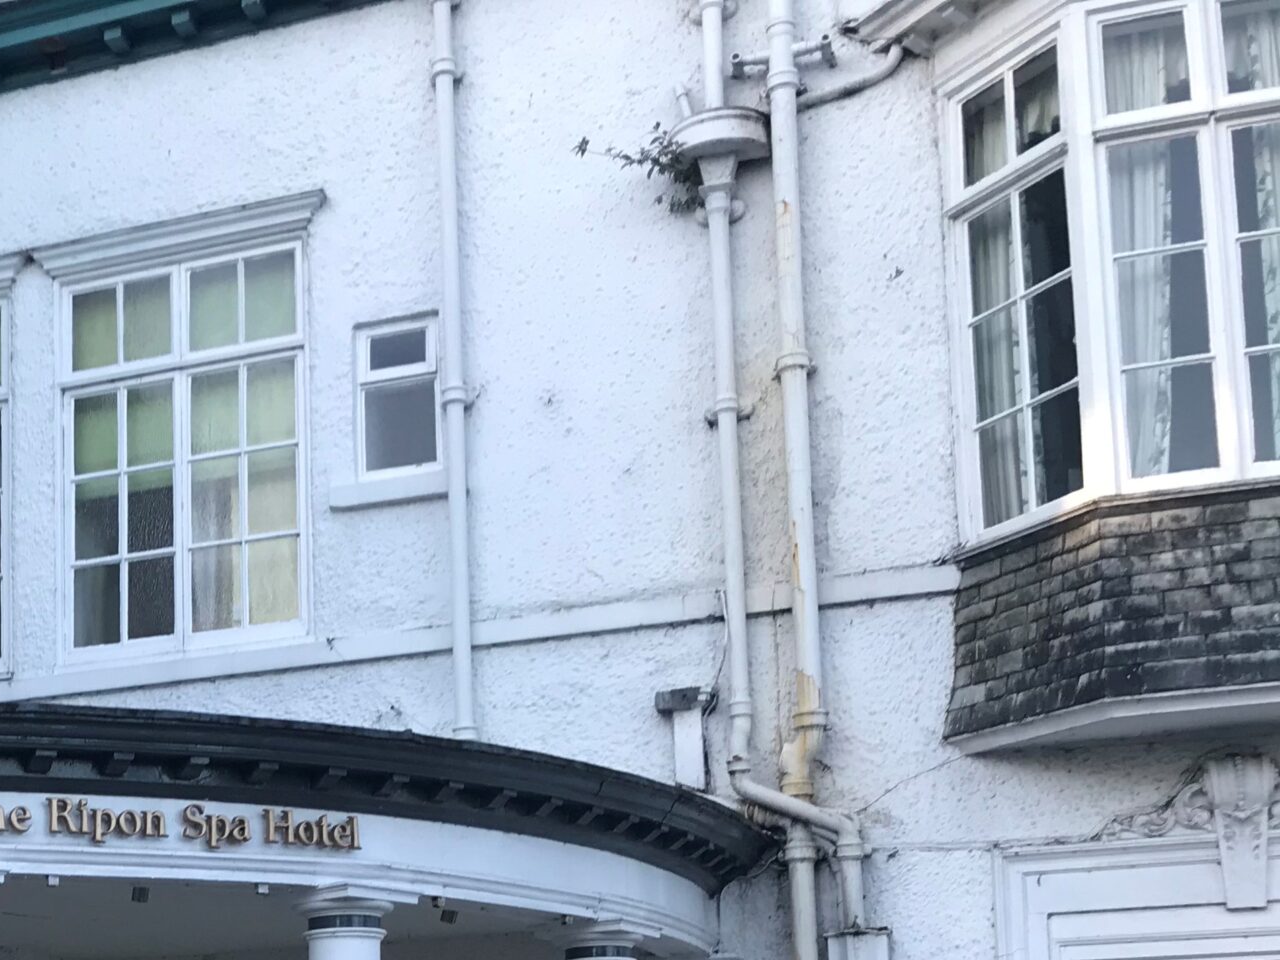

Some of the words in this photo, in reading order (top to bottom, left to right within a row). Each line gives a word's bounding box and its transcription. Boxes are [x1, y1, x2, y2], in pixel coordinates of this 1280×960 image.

[45, 796, 169, 844] Ripon
[182, 803, 252, 848] Spa
[263, 808, 362, 850] Hotel
